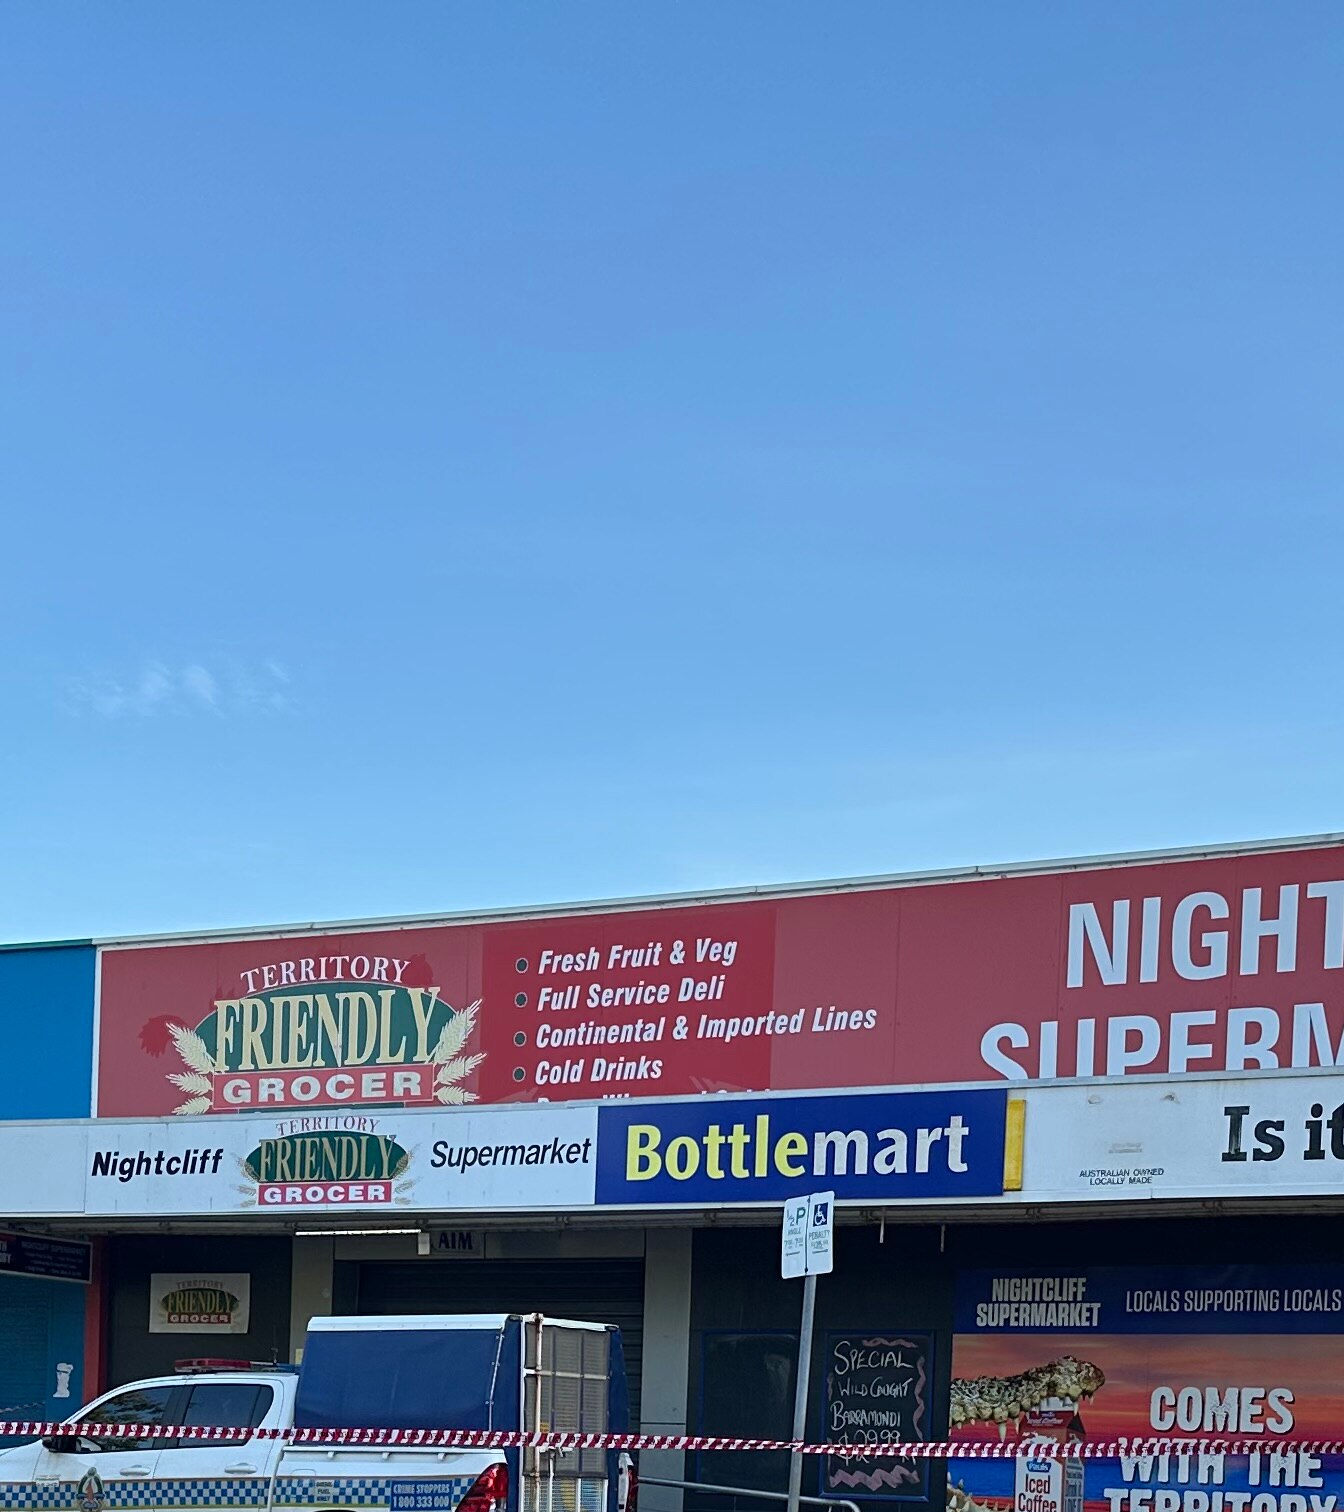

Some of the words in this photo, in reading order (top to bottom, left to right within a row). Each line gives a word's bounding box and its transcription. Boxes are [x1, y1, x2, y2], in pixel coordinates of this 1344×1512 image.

[538, 945, 599, 975] Fresh
[608, 942, 663, 969] Fruit
[670, 940, 685, 964] &
[696, 937, 737, 967] Veg
[240, 955, 411, 993] TERRITORY
[537, 983, 580, 1011] Full
[586, 979, 670, 1008] Service
[678, 975, 725, 1001] Deli
[214, 986, 440, 1072] FRIENDLY
[536, 1016, 665, 1048] Continental
[673, 1016, 688, 1040] &
[698, 1009, 805, 1043] Imported
[811, 1006, 878, 1031] Lines
[534, 1058, 582, 1085] Cold
[591, 1056, 663, 1081] Drinks
[223, 1071, 422, 1104] GROCER
[276, 1116, 380, 1135] TERRITORY
[1222, 1104, 1286, 1163] Is
[259, 1135, 397, 1183] FRIENDLY
[430, 1137, 592, 1174] Supermarket
[626, 1114, 970, 1181] Bottlemart
[92, 1148, 223, 1182] Nightcliff
[1079, 1168, 1130, 1177] AUSTRALIAN
[1133, 1168, 1164, 1176] OWNED
[264, 1184, 386, 1204] GROCER
[1090, 1177, 1126, 1185] LOCALLY
[1129, 1176, 1152, 1184] MADE
[176, 1279, 224, 1290] TERRITORY
[992, 1277, 1086, 1303] NIGHTCLIFF
[166, 1290, 234, 1313] FRIENDLY
[976, 1302, 1101, 1328] SUPERMARKET
[1126, 1289, 1180, 1313] LOCALS
[1184, 1289, 1280, 1312] SUPPORTING
[1283, 1289, 1342, 1312] LOCALS
[170, 1314, 229, 1323] GROCER
[834, 1340, 914, 1375] SPECIAL
[838, 1377, 868, 1396] WILD
[830, 1400, 900, 1431] BARRAMUNDI
[1149, 1386, 1294, 1433] COMES
[1118, 1438, 1225, 1484] WITH
[1248, 1438, 1323, 1488] THE
[393, 1484, 415, 1494] CRIME
[416, 1483, 450, 1494] STOPPERS
[1025, 1474, 1050, 1494] Iced
[398, 1496, 414, 1507] 800
[416, 1496, 432, 1507] 333
[434, 1496, 450, 1507] 000
